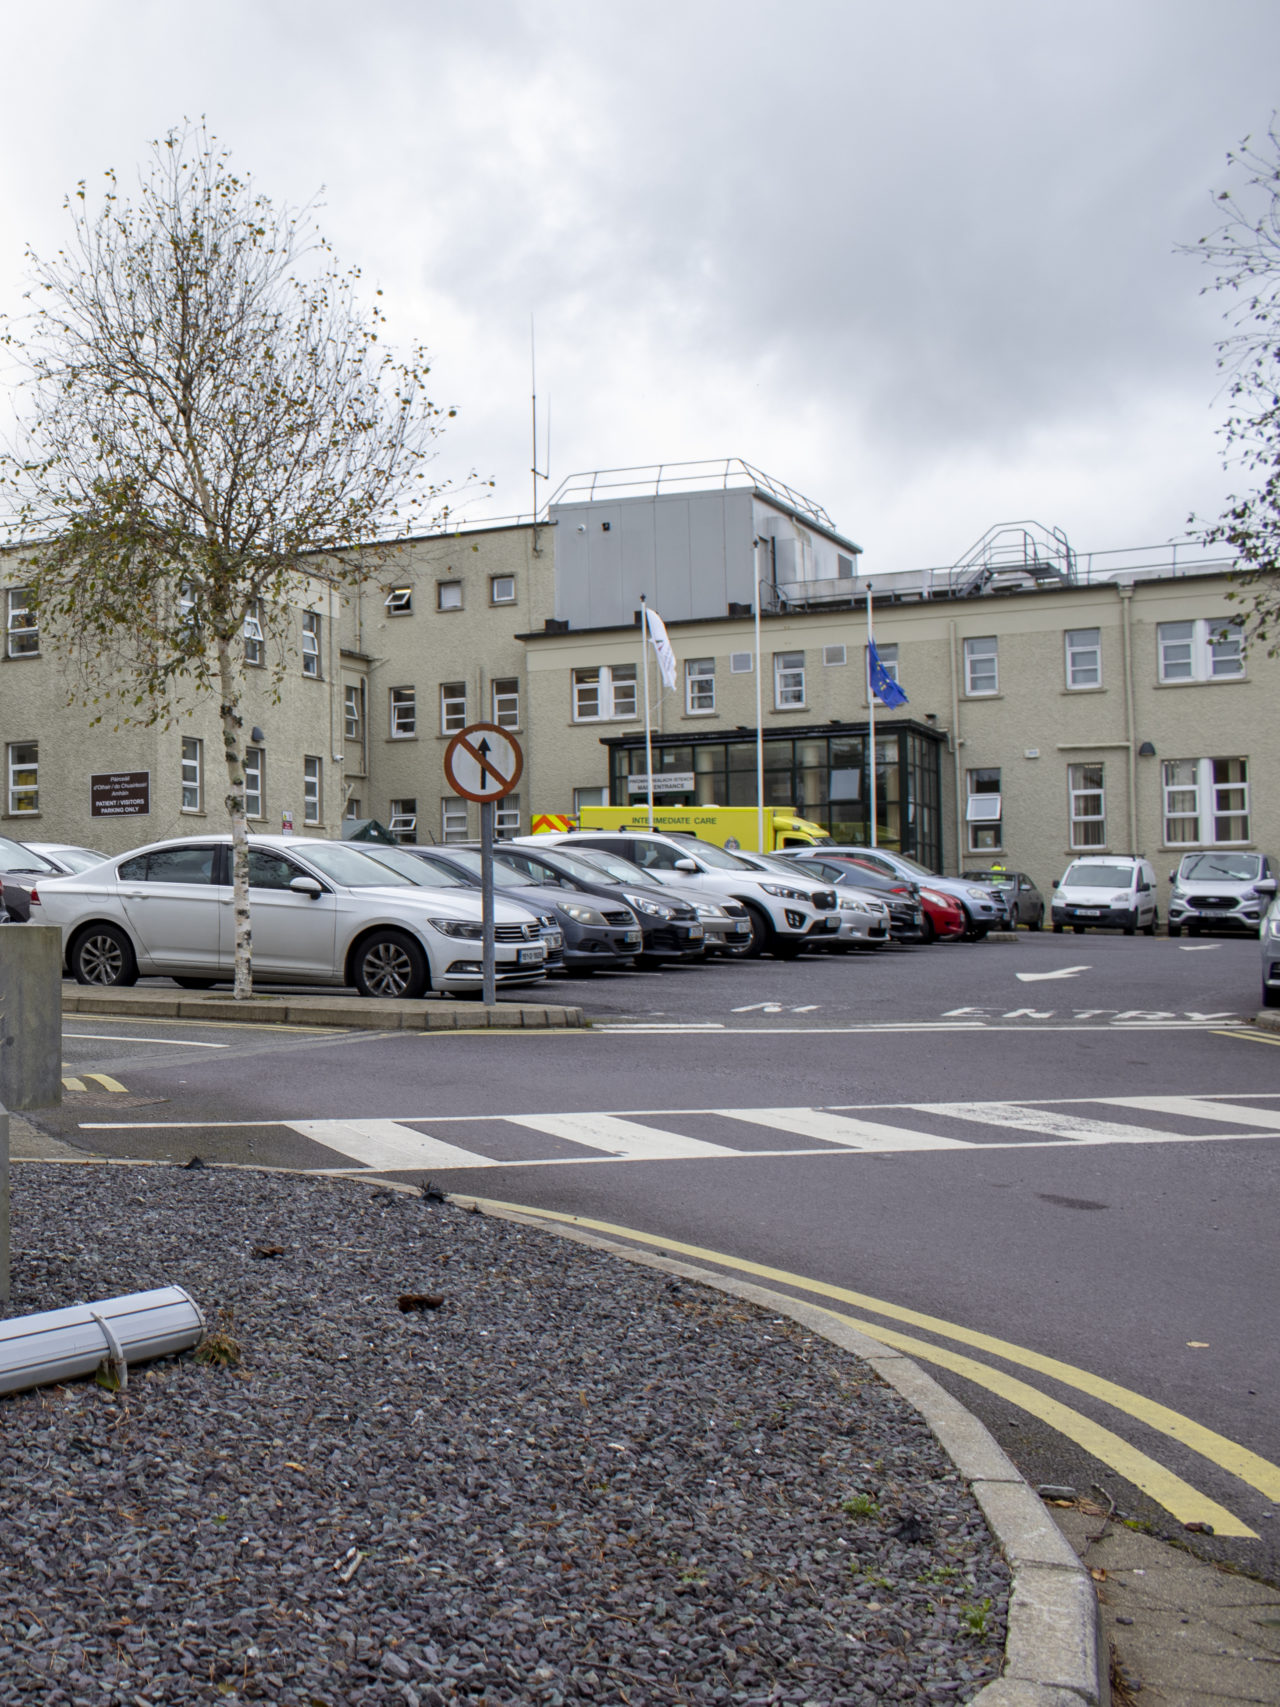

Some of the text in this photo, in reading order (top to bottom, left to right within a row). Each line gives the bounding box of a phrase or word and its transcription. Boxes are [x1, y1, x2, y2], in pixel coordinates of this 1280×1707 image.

[632, 816, 717, 825] INTEMEDIATE CARE
[941, 1007, 1239, 1021] ENTRY
